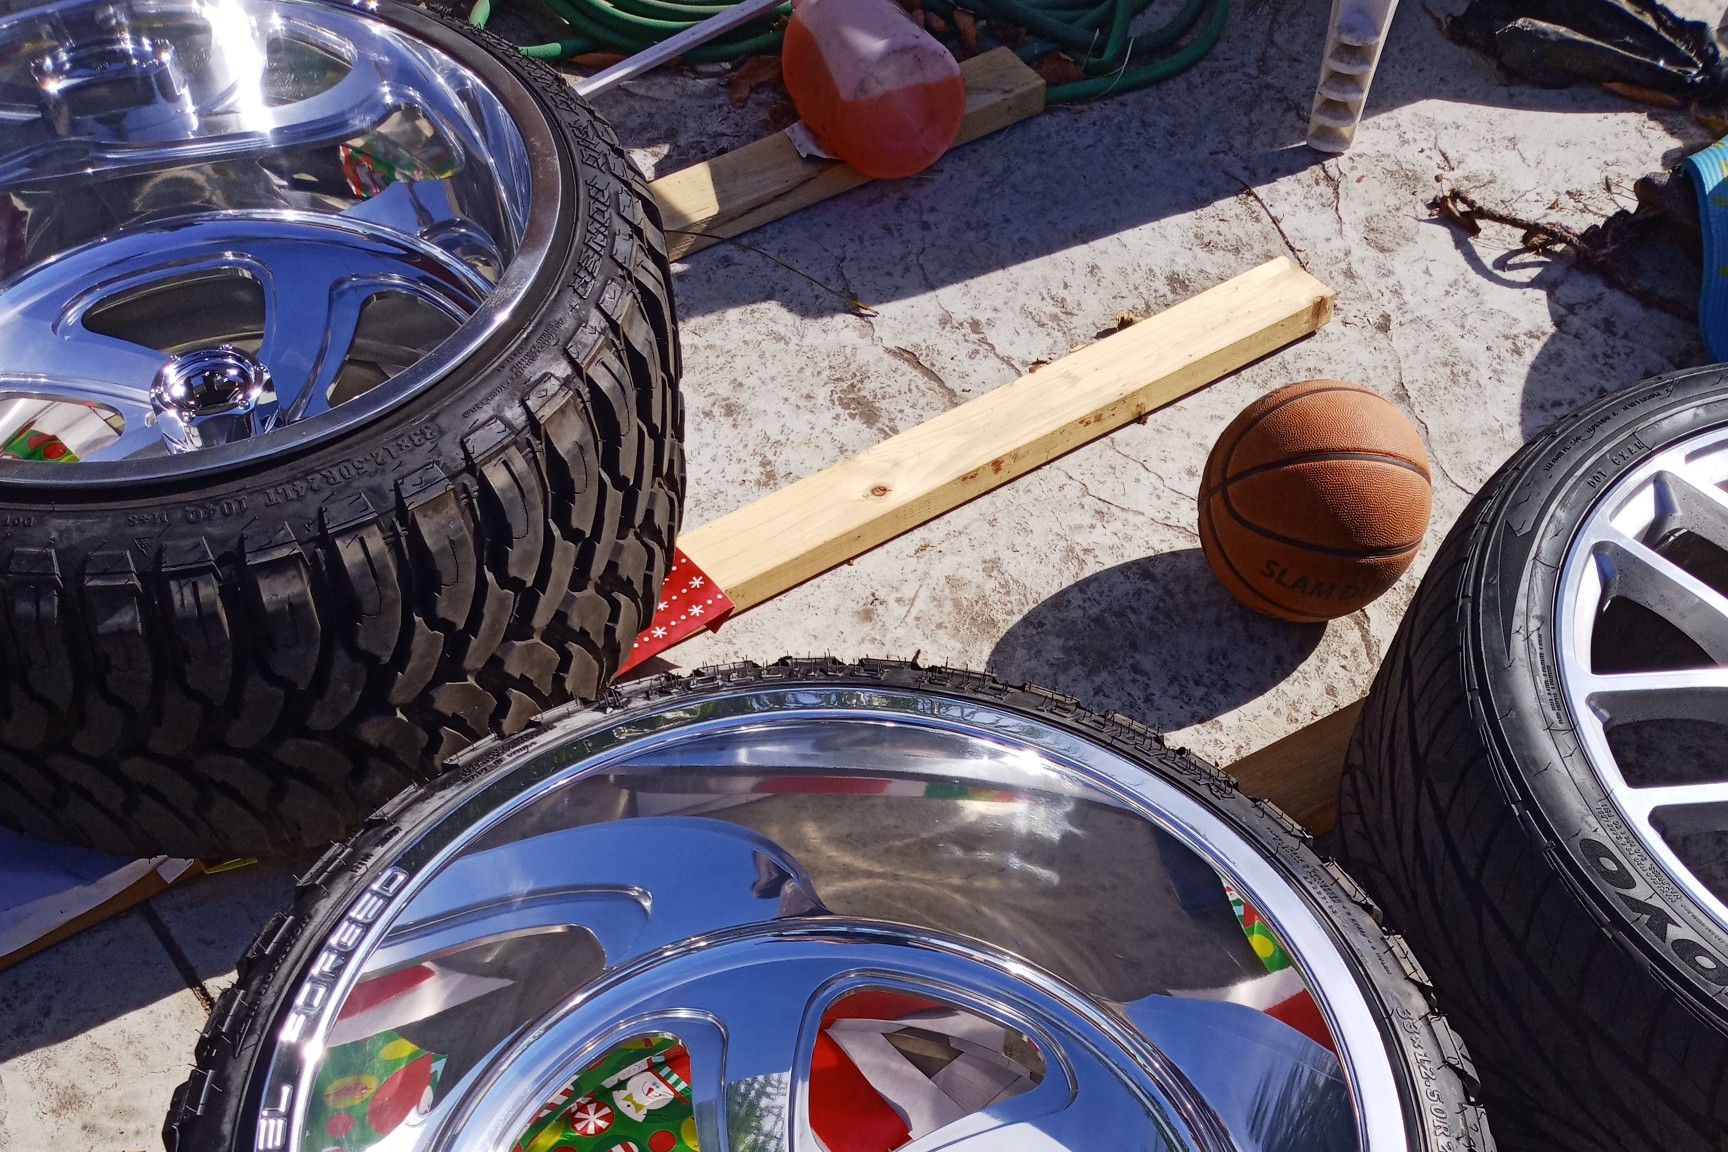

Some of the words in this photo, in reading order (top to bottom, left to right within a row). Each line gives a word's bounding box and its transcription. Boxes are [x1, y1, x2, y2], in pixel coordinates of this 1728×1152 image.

[567, 176, 611, 300] POWER
[1259, 558, 1337, 599] SLAM
[278, 864, 411, 1044] FORGED
[1579, 838, 1728, 987] OYO
